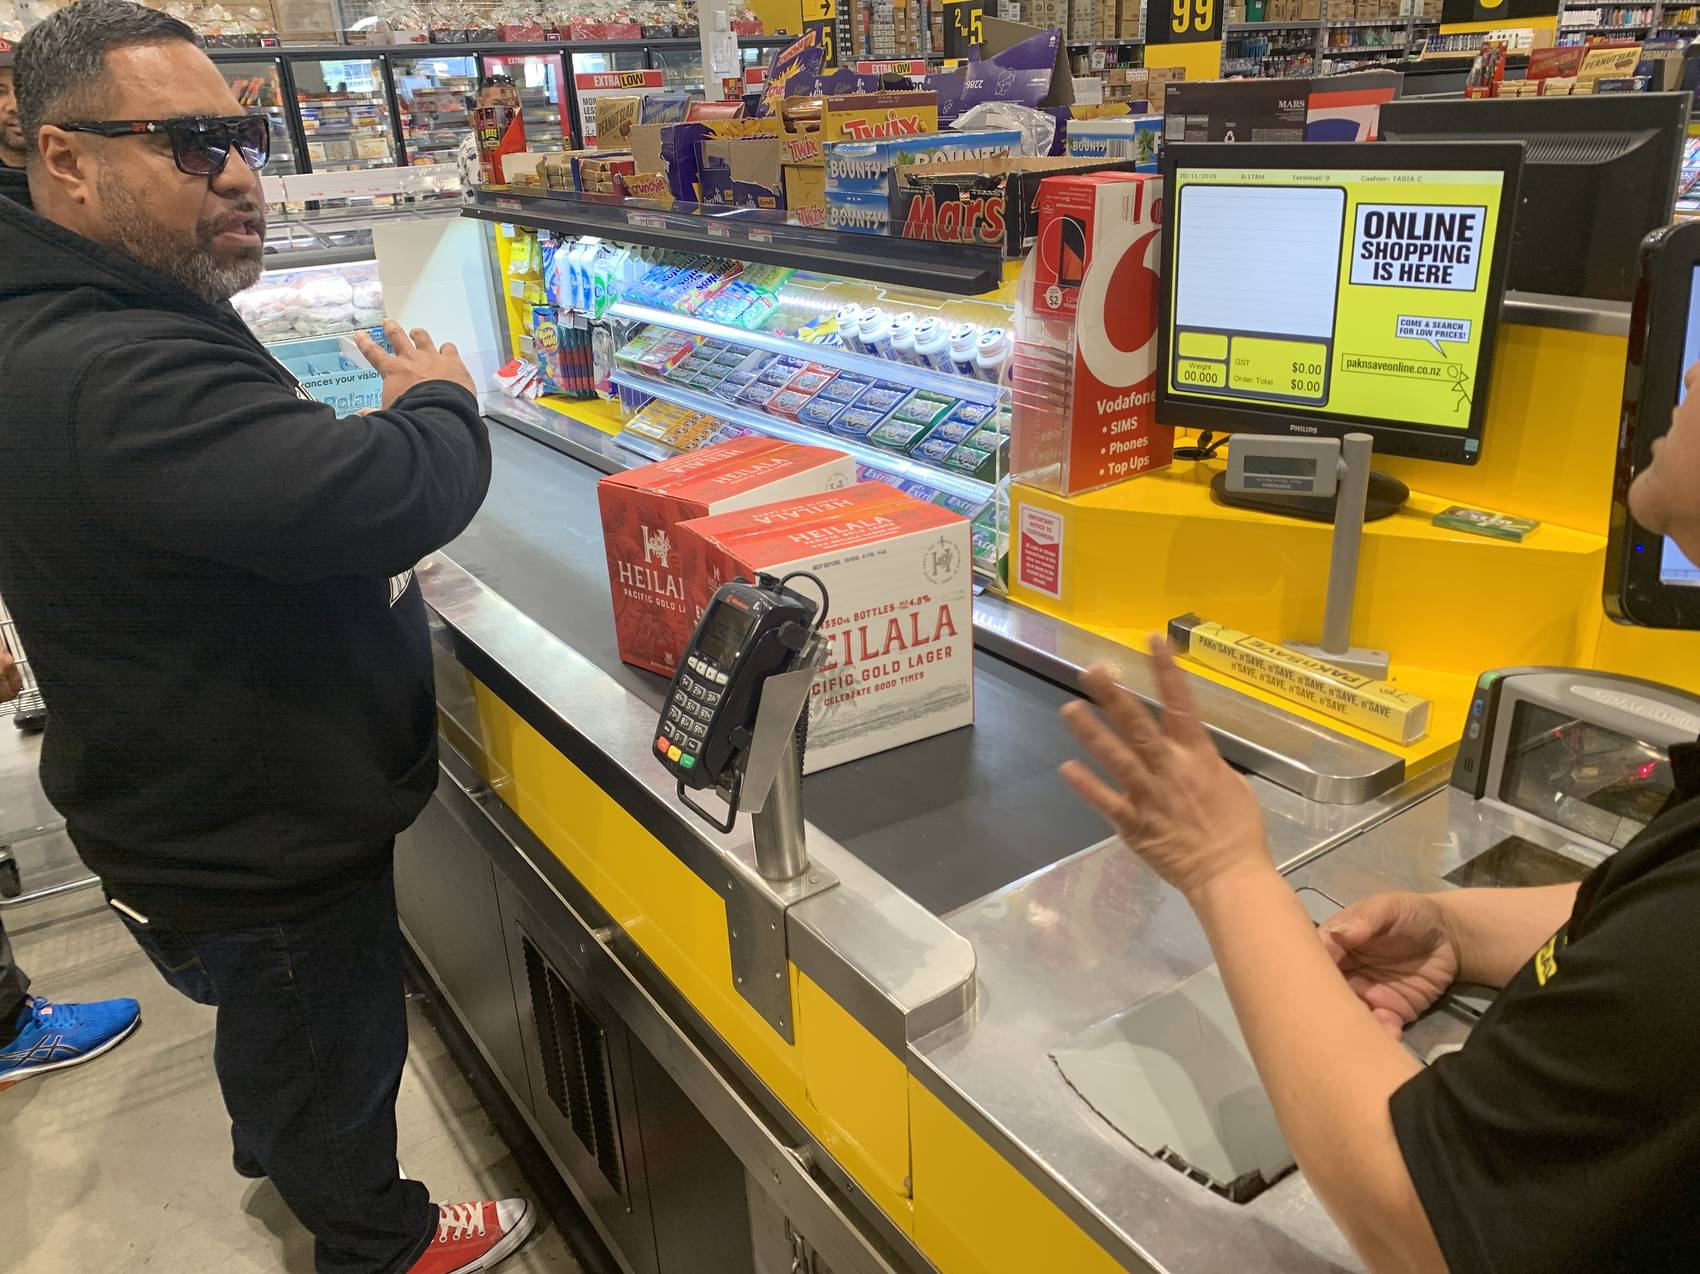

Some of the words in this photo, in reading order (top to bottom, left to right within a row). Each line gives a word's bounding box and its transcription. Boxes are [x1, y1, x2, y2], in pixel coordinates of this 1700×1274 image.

[954, 8, 962, 28] 2
[1585, 55, 1617, 71] PEANUT
[1617, 49, 1638, 60] SLAB
[594, 75, 620, 88] EXTRA
[622, 73, 643, 87] LOW
[1278, 100, 1305, 108] MARS
[1072, 139, 1107, 152] BOUNTY
[830, 158, 887, 180] BOUNTY
[831, 207, 888, 230] BOUNTY
[902, 193, 1006, 242] Mars
[1363, 210, 1476, 242] ONLINE
[1361, 241, 1472, 264] SHOPPING
[1373, 262, 1394, 281] IS
[1399, 263, 1454, 284] HERE
[1400, 319, 1423, 327] COME
[1424, 320, 1430, 328] &
[1432, 321, 1464, 330] SEARCH
[1400, 327, 1414, 335] FOR
[1435, 330, 1466, 339] PRICES!
[1184, 370, 1218, 383] 00.000
[1189, 362, 1212, 371] Weight
[1292, 362, 1322, 375] $0.00
[1346, 358, 1441, 376] paknsaveonline.co.nz
[335, 375, 355, 386] your
[1234, 375, 1253, 383] Order
[1256, 377, 1274, 385] Total
[1290, 379, 1320, 392] $0.00
[324, 390, 381, 409] Polari
[1096, 390, 1156, 415] Vodafone
[1110, 416, 1138, 435] SIMS
[1290, 425, 1318, 434] PHILIPS
[1109, 436, 1149, 455] Phones
[712, 457, 789, 484] HEILALA
[1107, 462, 1128, 475] Top
[1129, 455, 1150, 471] Ups
[907, 485, 931, 500] Extr
[754, 499, 855, 525] HEILALA
[787, 516, 893, 543] HEILALA
[618, 561, 685, 600] HEILA
[624, 588, 653, 604] PACIFIC
[655, 597, 676, 609] GOLD
[853, 604, 895, 621] BOTTLES
[817, 603, 958, 673] EILALA
[812, 674, 854, 696] CIFIC
[862, 660, 900, 682] GOLD
[909, 646, 952, 669] LAGER
[824, 687, 872, 707] CELEBRATE
[874, 679, 897, 693] GOOD
[900, 671, 925, 685] TIMES
